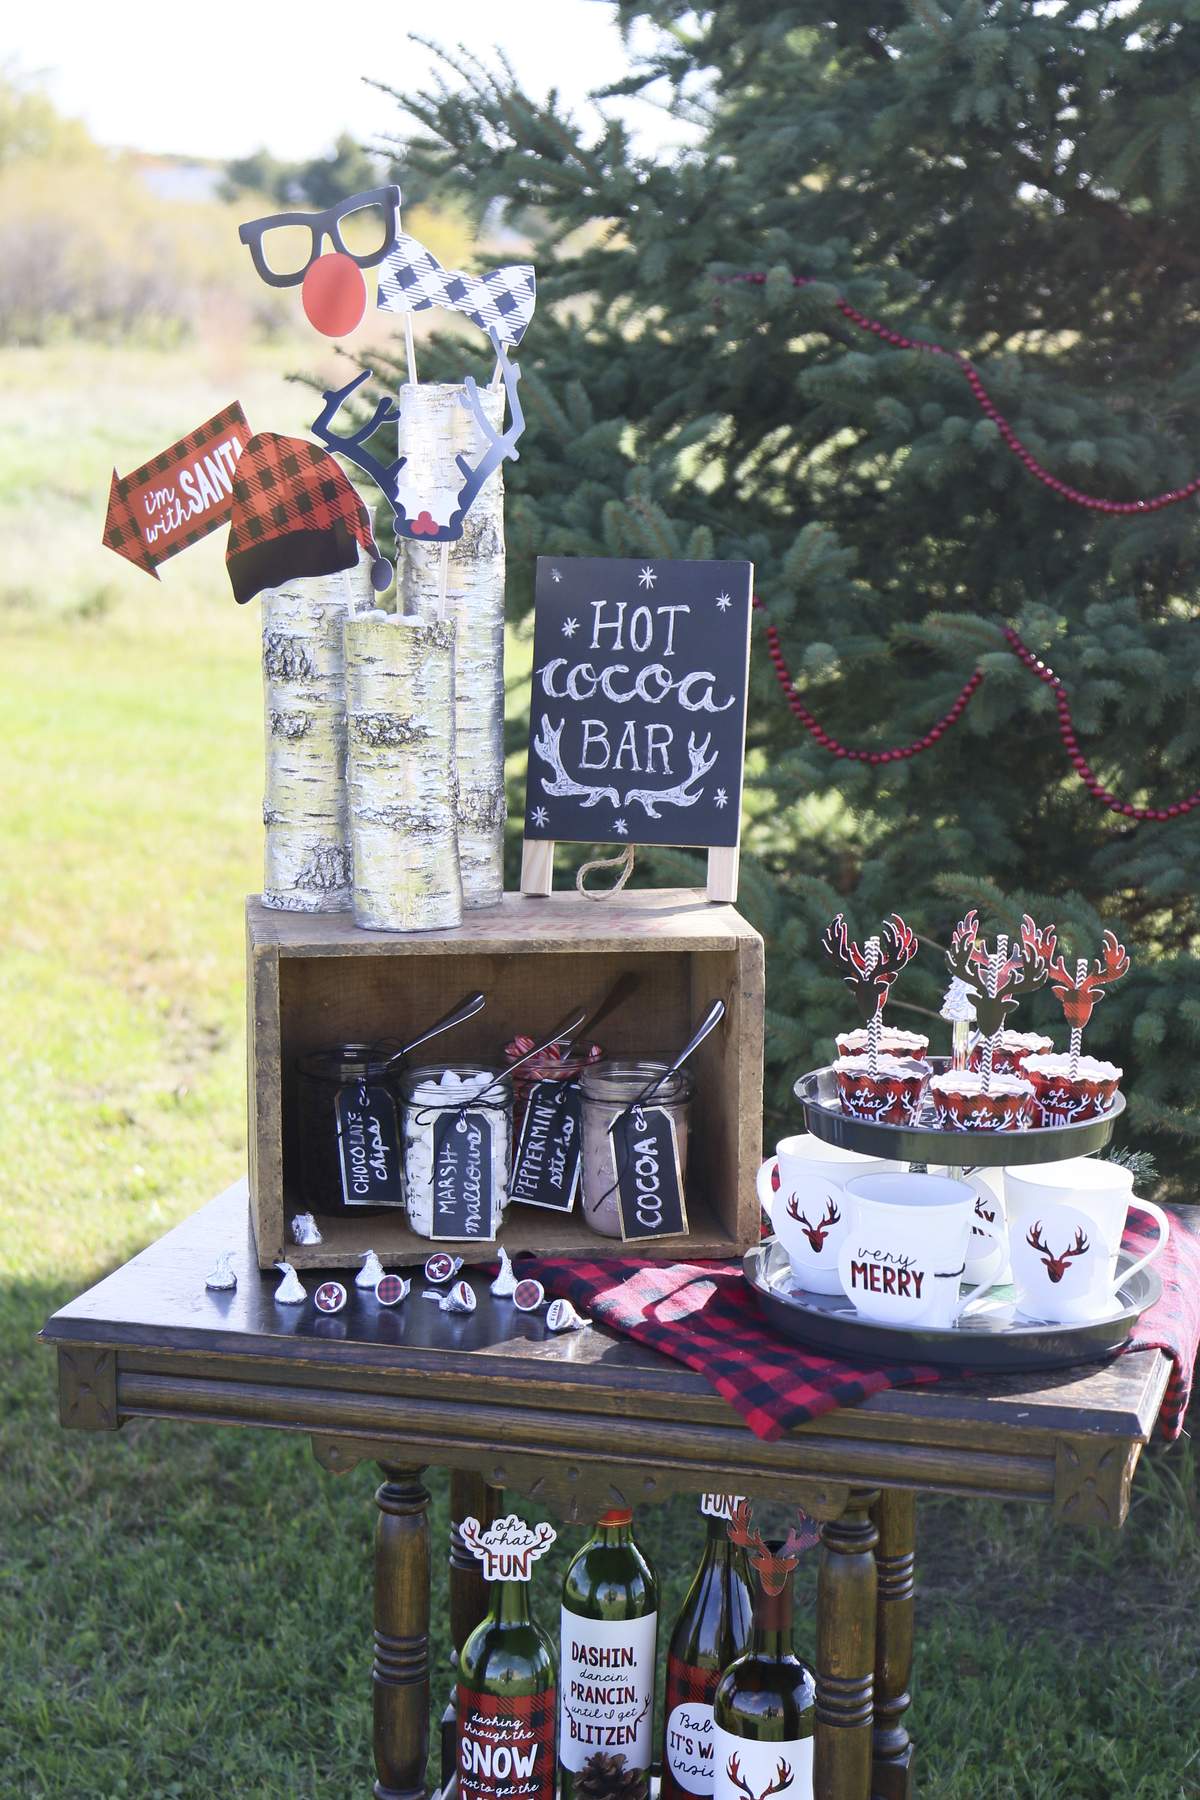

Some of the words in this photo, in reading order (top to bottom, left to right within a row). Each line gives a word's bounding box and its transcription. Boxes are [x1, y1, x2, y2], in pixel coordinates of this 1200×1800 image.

[145, 498, 190, 544] with
[589, 600, 691, 656] HOT
[578, 720, 675, 775] BAR
[850, 1097, 883, 1109] what
[855, 1087, 875, 1098] oh
[1040, 1097, 1077, 1109] what
[1048, 1088, 1070, 1099] oh
[963, 1117, 1001, 1128] what
[971, 1107, 993, 1118] oh
[347, 1111, 371, 1194] CHOCOLATE
[367, 1115, 391, 1181] chips
[439, 1143, 459, 1215] MARSH
[463, 1124, 482, 1234] mallows
[633, 1136, 664, 1229] COCOA
[858, 1247, 917, 1271] very
[850, 1260, 925, 1299] MERRY
[495, 1518, 523, 1532] oh
[485, 1532, 534, 1546] what
[487, 1553, 528, 1578] FUN
[471, 1712, 524, 1730] dashing
[570, 1705, 603, 1719] until
[604, 1709, 616, 1720] I
[617, 1707, 638, 1722] get
[680, 1712, 714, 1733] Bab
[464, 1721, 511, 1743] through
[512, 1729, 535, 1740] the
[570, 1720, 637, 1746] BLITZEN
[670, 1731, 693, 1756] IT'S
[461, 1736, 539, 1779] SNOW
[673, 1756, 715, 1778] insi
[480, 1782, 494, 1792] to
[495, 1785, 518, 1798] get
[518, 1783, 540, 1793] the
